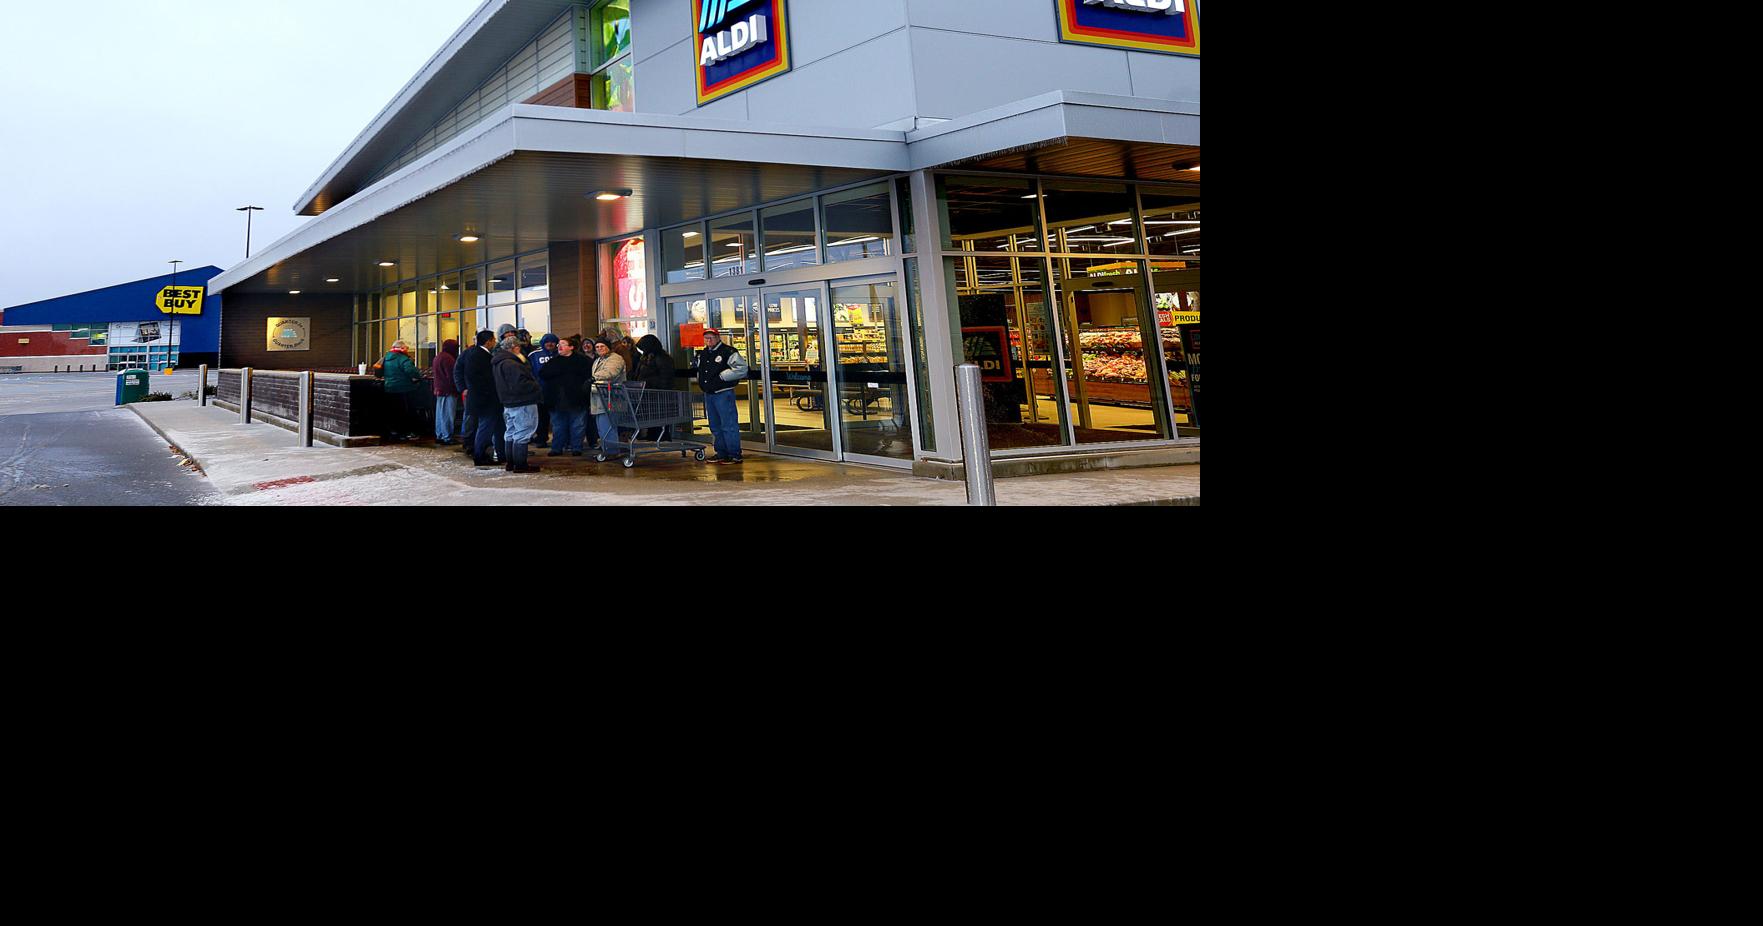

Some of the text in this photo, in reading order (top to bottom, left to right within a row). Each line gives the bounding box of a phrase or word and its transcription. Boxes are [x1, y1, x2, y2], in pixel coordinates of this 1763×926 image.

[700, 14, 763, 66] ALDI
[163, 289, 201, 299] BEST
[163, 299, 197, 309] BUY
